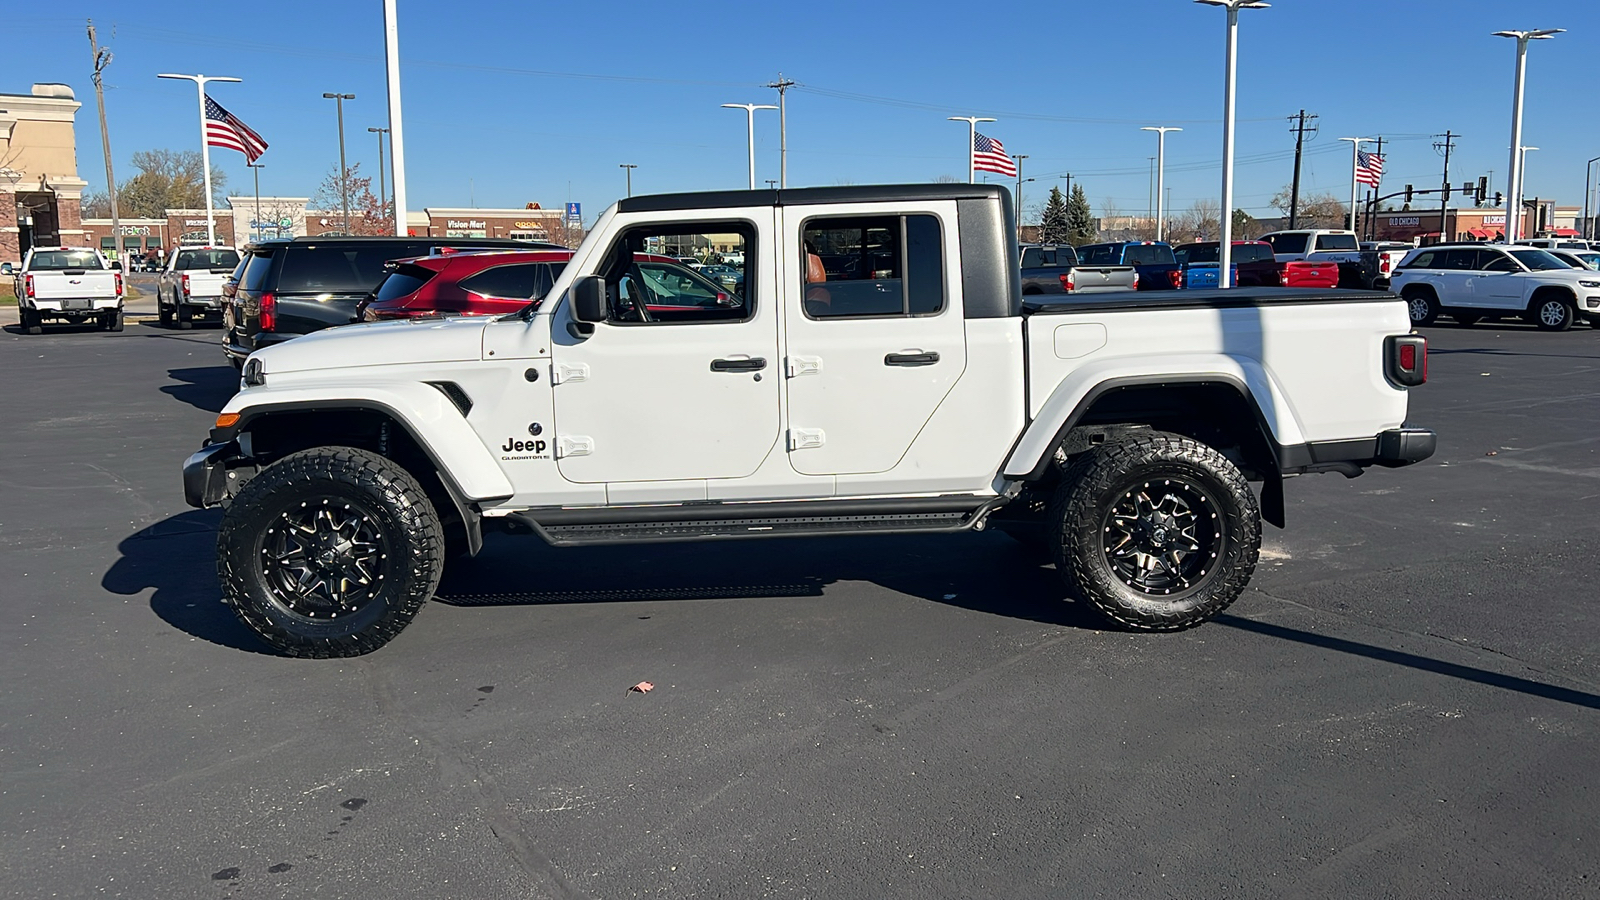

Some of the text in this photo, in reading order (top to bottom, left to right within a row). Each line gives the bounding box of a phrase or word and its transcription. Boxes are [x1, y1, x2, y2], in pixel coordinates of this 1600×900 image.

[447, 219, 486, 229] Vision Mart
[501, 437, 547, 454] Jeep
